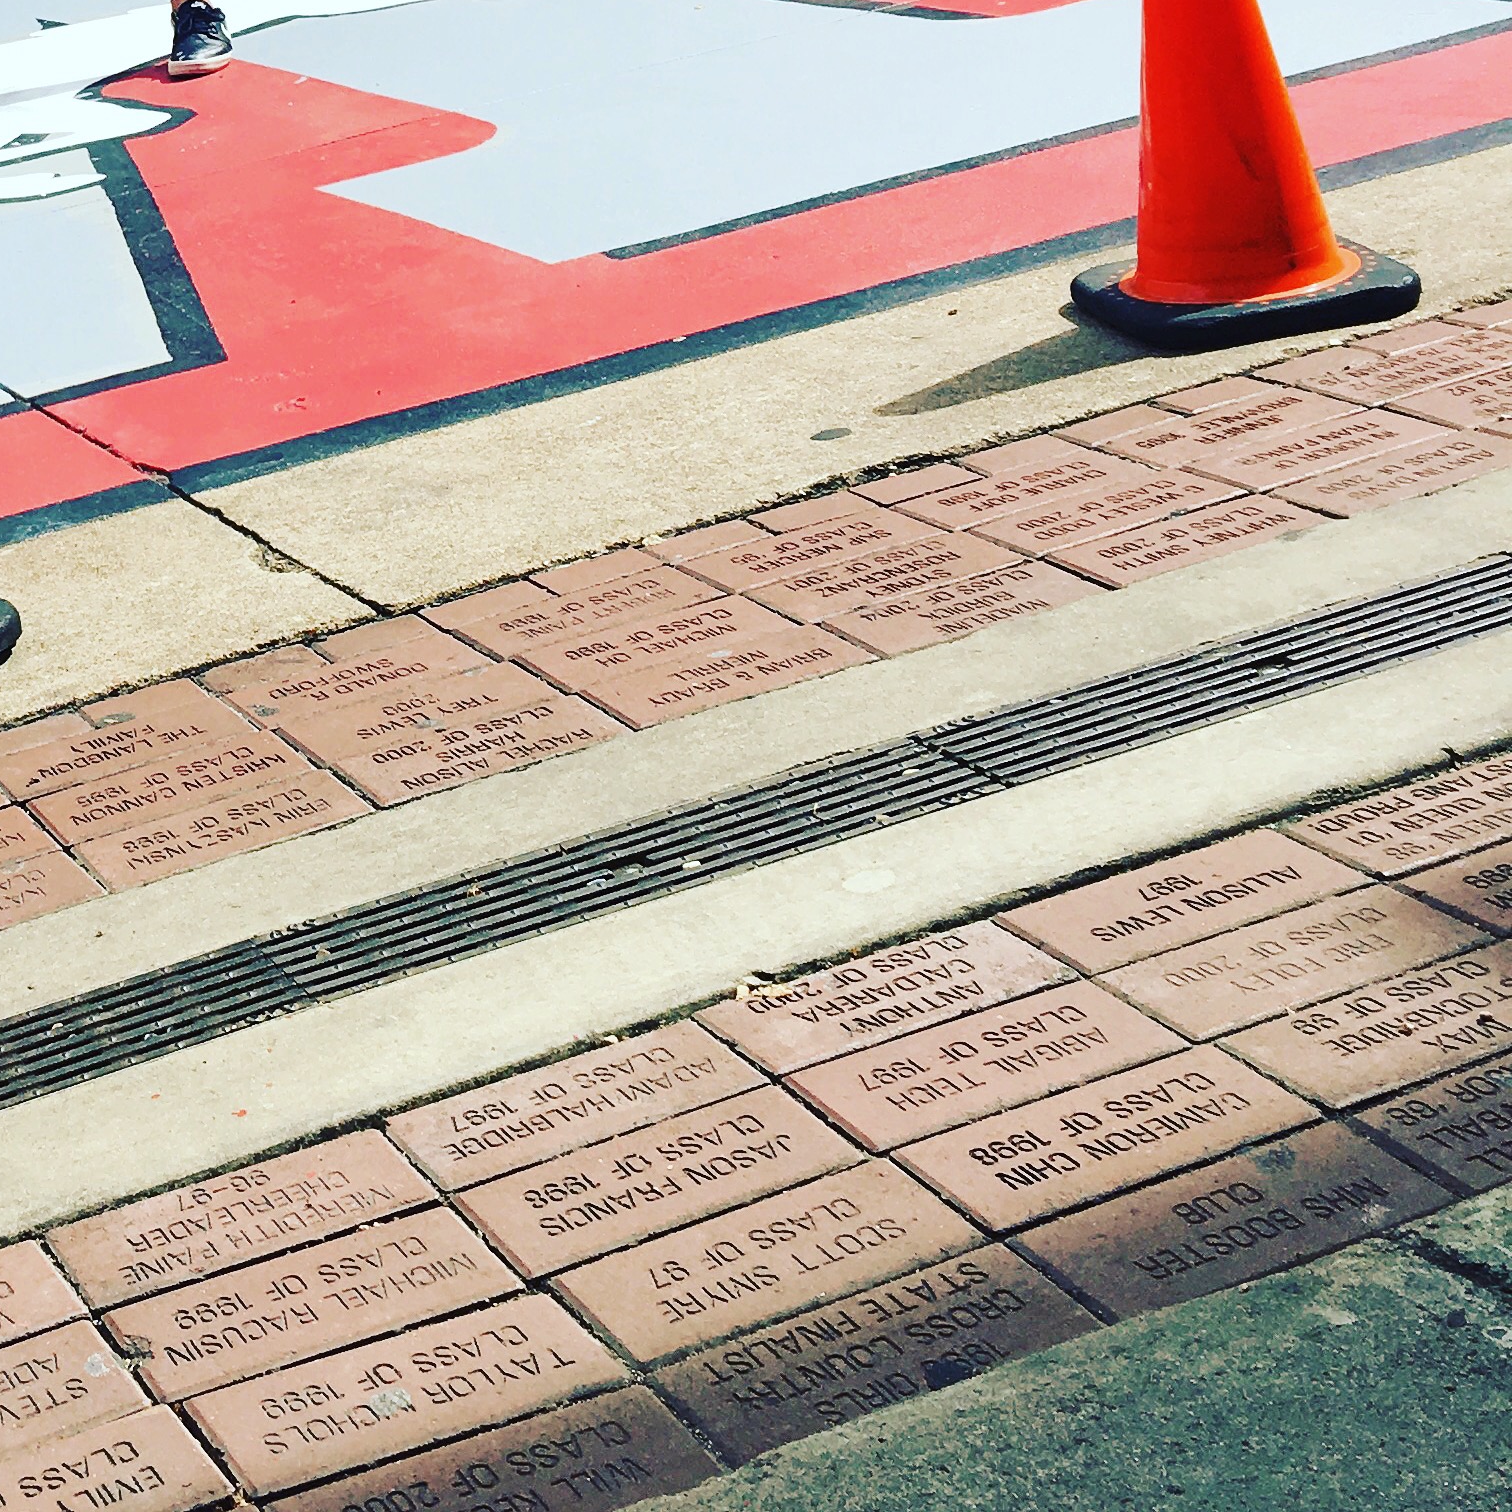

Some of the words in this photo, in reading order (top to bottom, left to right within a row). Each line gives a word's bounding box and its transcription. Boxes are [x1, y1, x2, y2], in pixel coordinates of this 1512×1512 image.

[1111, 543, 1191, 572] SMITH
[635, 623, 738, 655] MICHAEL
[268, 657, 395, 701] SWOFFORD
[333, 661, 430, 695] DONALD
[670, 649, 770, 682] MERRILL
[754, 646, 834, 677] BRIAN
[436, 693, 500, 715] TREY
[647, 677, 731, 706] BRADY
[69, 723, 156, 754] FAMILY
[156, 724, 207, 745] THE
[356, 711, 432, 741] LEWIS
[439, 729, 471, 747] OF
[473, 705, 555, 735] CLASS
[175, 745, 255, 778] CLASS
[371, 739, 433, 765] 2000
[434, 730, 527, 764] HARRIS
[495, 727, 594, 761] RACHEL
[139, 771, 171, 789] OF
[180, 752, 287, 793] KRISTEN
[399, 756, 490, 791] ALISON
[1410, 759, 1512, 801] STANG
[69, 786, 178, 827] CANNON
[226, 787, 308, 821] CLASS
[272, 797, 332, 825] ERIN
[1307, 797, 1416, 835] PROUD!
[1389, 796, 1487, 833] QUEEN
[188, 815, 221, 834] OF
[1137, 873, 1204, 903] 1997
[1179, 864, 1303, 913] ALLISON
[1089, 904, 1185, 943] LEWIS
[1288, 906, 1389, 947] CLASS
[871, 934, 969, 974] CLASS
[1247, 940, 1288, 960] OF
[1328, 932, 1396, 964] ERIC
[831, 967, 869, 990] OF
[1164, 954, 1243, 988] 2000
[1384, 959, 1492, 1004] CLASS
[790, 958, 976, 1024] CALDARERA
[839, 980, 985, 1038] ANTHONY
[1342, 995, 1388, 1020] OF
[980, 1004, 1088, 1049] CLASS
[572, 1046, 676, 1090] CLASS
[938, 1040, 980, 1066] OF
[982, 1026, 1109, 1074] ABIGAIL
[528, 1082, 568, 1107] OF
[615, 1057, 717, 1102] ADAM
[857, 1057, 931, 1093] 1997
[884, 1071, 987, 1112] TEICH
[1103, 1071, 1216, 1120] CLASS
[443, 1093, 616, 1162] HALBRIDGE
[449, 1099, 520, 1134] 1997
[1058, 1111, 1104, 1139] OF
[1077, 1091, 1251, 1162] CAMERON
[655, 1113, 766, 1163] CLASS
[967, 1129, 1052, 1167] 1998
[610, 1152, 653, 1181] OF
[681, 1133, 792, 1186] JASON
[994, 1151, 1082, 1191] CHIN
[523, 1172, 602, 1210] 1998
[539, 1176, 683, 1238] FRANCIS
[1171, 1181, 1266, 1227] CLUB
[125, 1170, 350, 1254] CHEERLEADER
[224, 1185, 396, 1250] MEREDITH
[747, 1197, 862, 1251] CLASS
[117, 1240, 221, 1286] PAINE
[317, 1235, 429, 1285] CLASS
[703, 1240, 747, 1271] OF
[790, 1217, 907, 1275] SCOTT
[1133, 1207, 1306, 1281] BOOSTER
[265, 1273, 309, 1303] OF
[323, 1252, 478, 1311] MICHAEL
[648, 1259, 691, 1290] 97
[656, 1264, 781, 1324] SMYRE
[858, 1261, 991, 1324] STATE
[173, 1292, 254, 1331] 1999
[903, 1288, 1028, 1346] CROSS
[163, 1302, 320, 1367] RACUSIN
[411, 1324, 530, 1374] CLASS
[701, 1310, 862, 1387] FINALIST
[357, 1362, 404, 1392] OF
[420, 1348, 577, 1405] TAYLOR
[260, 1383, 346, 1421] 1999
[812, 1371, 921, 1427] GIRLS
[262, 1403, 417, 1455] CHOLS
[505, 1420, 633, 1478] CLASS
[17, 1440, 140, 1499] CLASS
[450, 1462, 502, 1499] OF
[549, 1456, 653, 1501] WILL
